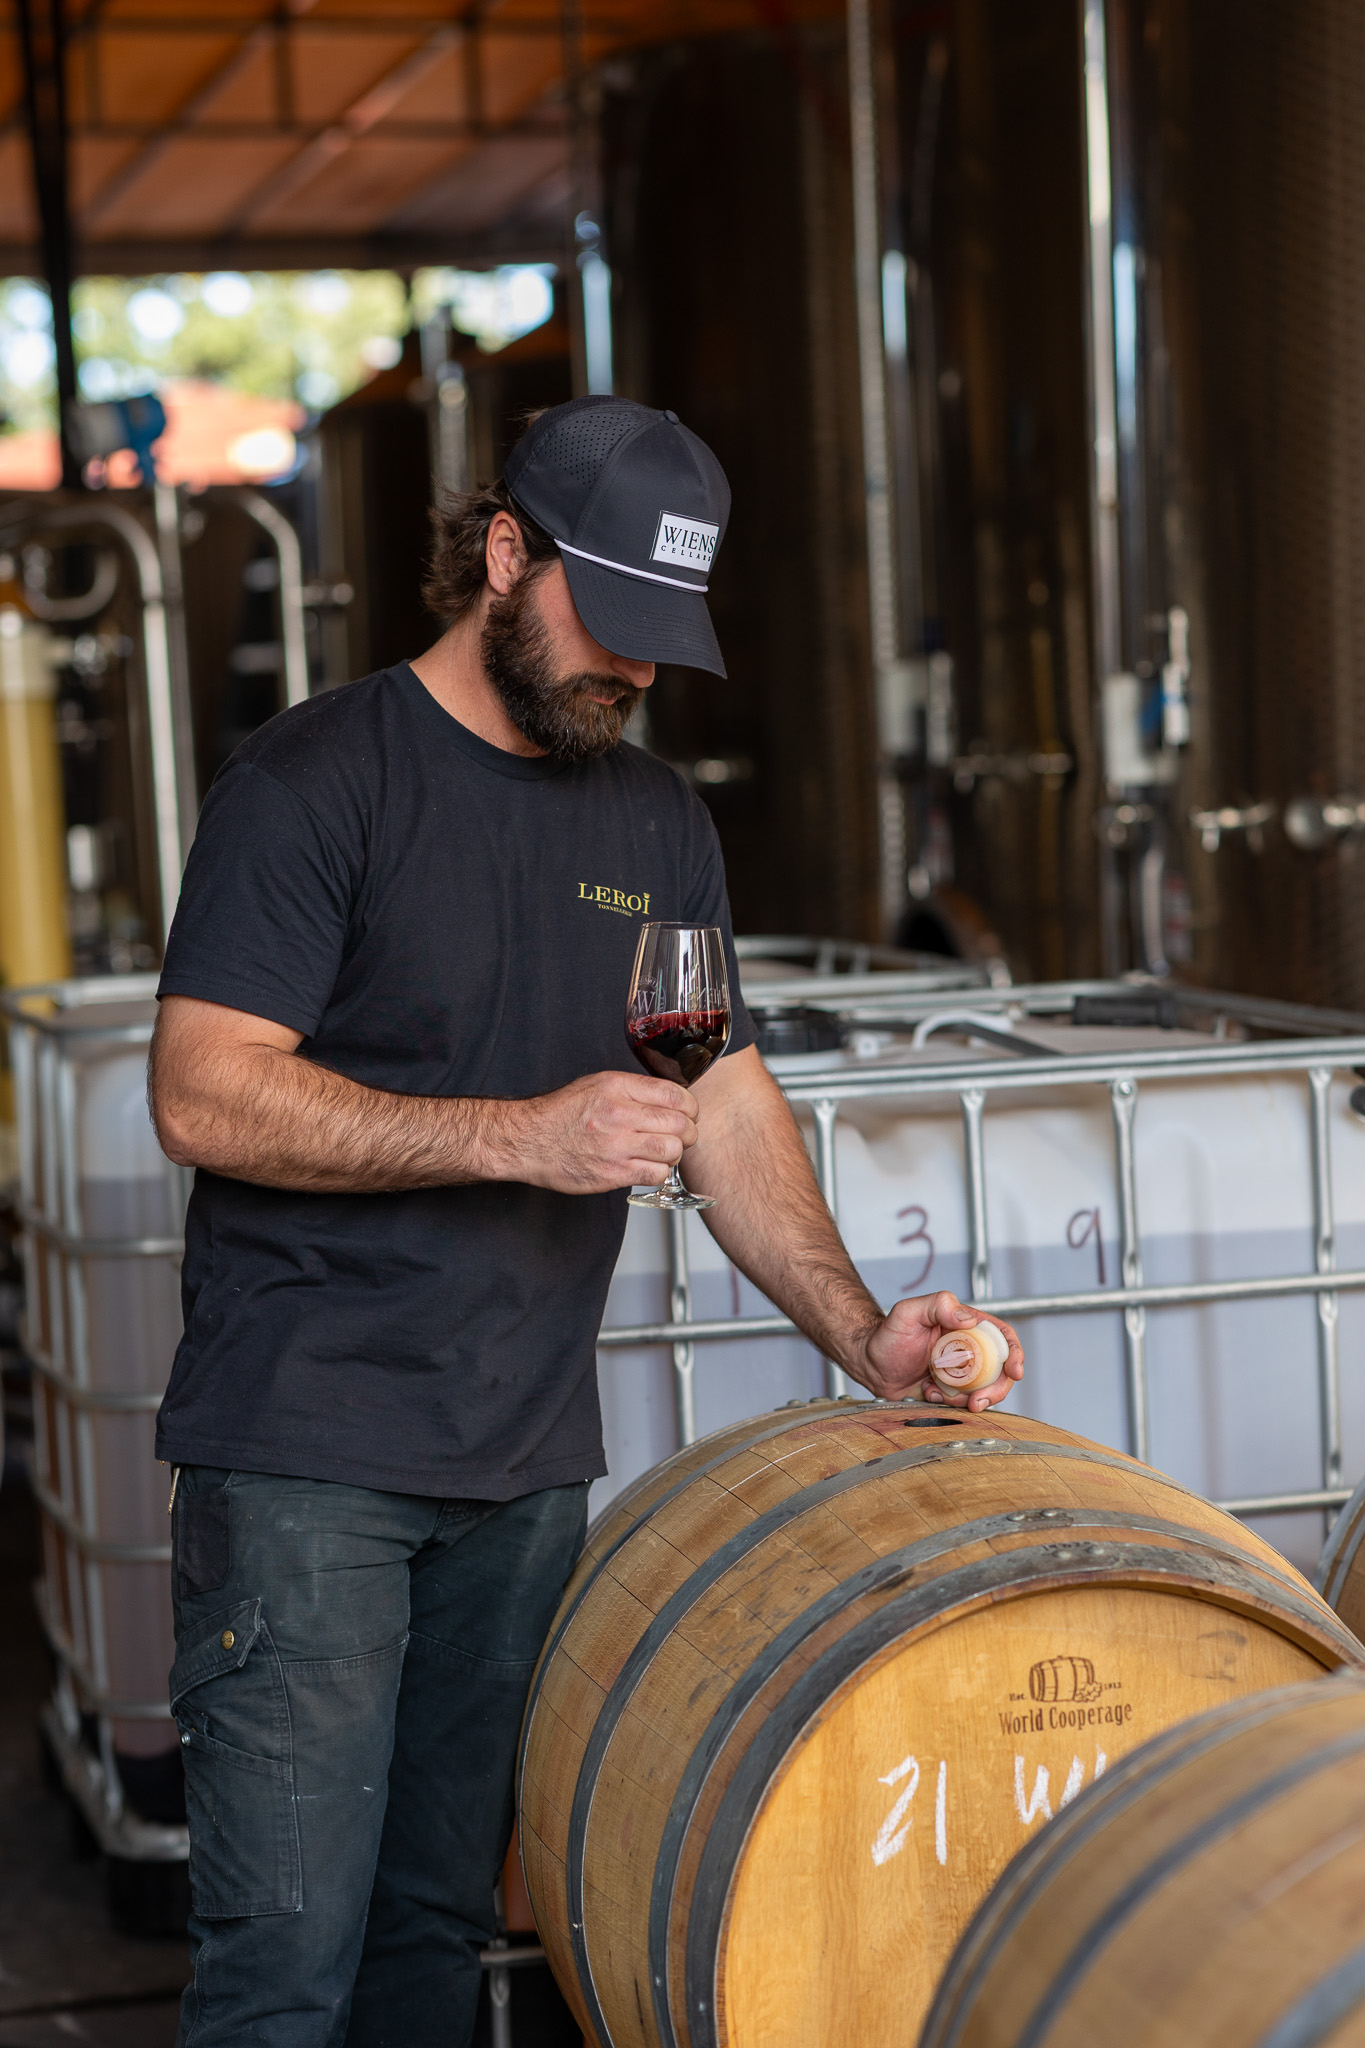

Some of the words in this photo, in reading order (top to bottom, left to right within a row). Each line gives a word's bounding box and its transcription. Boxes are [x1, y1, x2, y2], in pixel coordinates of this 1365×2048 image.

[661, 545, 711, 562] CELLARS
[664, 525, 716, 553] WIENS
[898, 1205, 935, 1293] 3
[1067, 1206, 1106, 1285] 9
[998, 1708, 1043, 1736] World
[1049, 1703, 1132, 1730] Cooperage
[871, 1755, 947, 1867] 21
